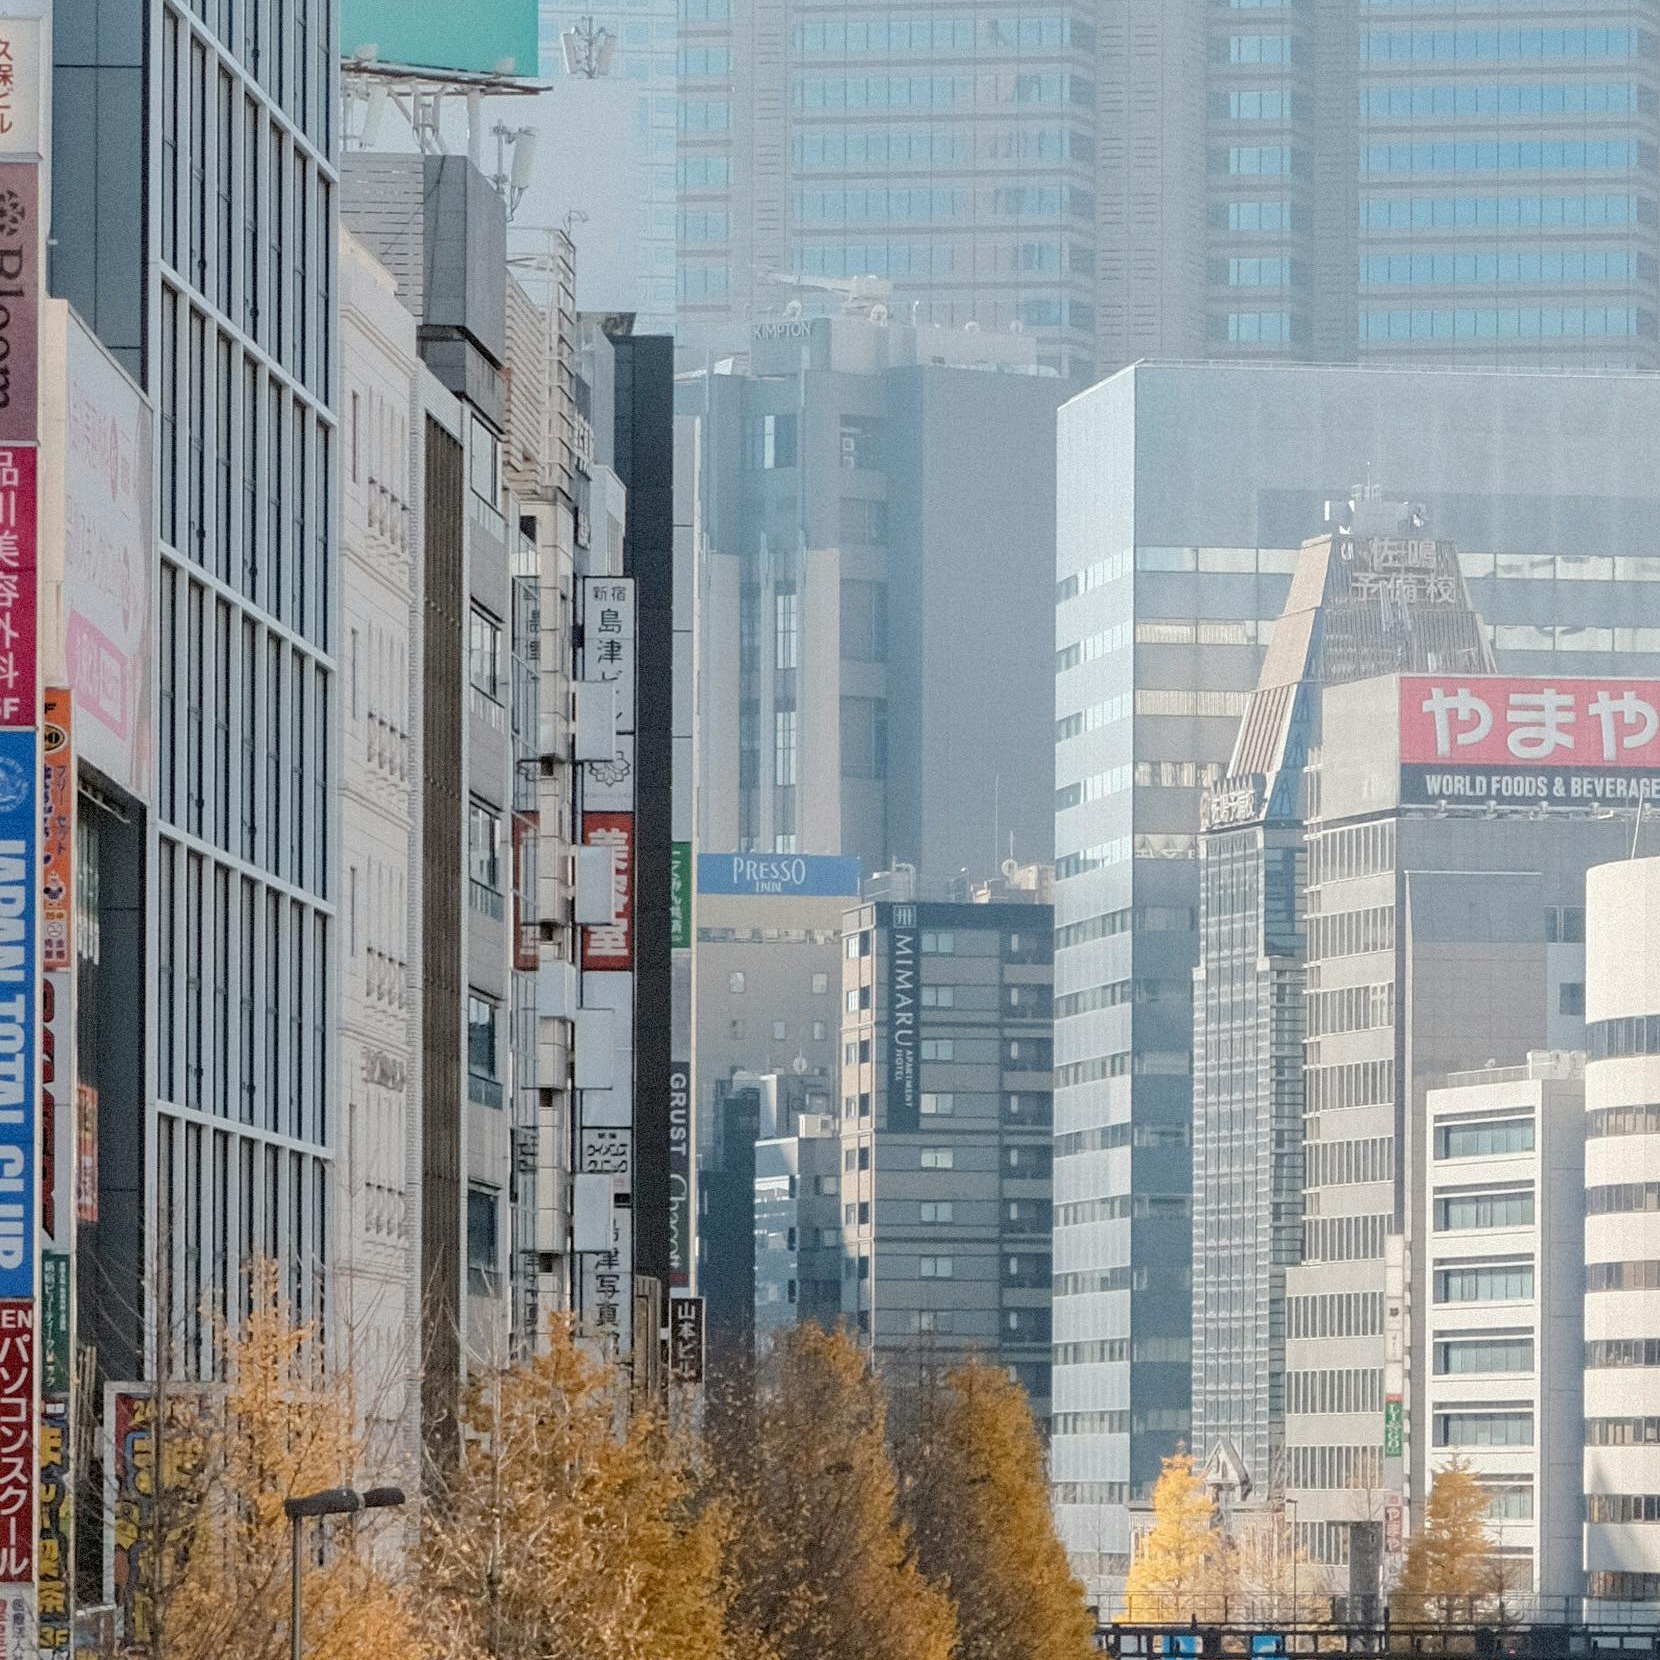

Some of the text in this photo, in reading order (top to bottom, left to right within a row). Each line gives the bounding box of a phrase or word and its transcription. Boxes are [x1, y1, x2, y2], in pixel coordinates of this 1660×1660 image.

[1423, 687, 1659, 761] やまや
[1425, 774, 1487, 799] WORLD
[1491, 774, 1548, 799] FOODS
[1553, 775, 1567, 798] &
[733, 857, 806, 885] PRESSO
[756, 881, 783, 893] INN
[895, 934, 914, 1047] MIMARU
